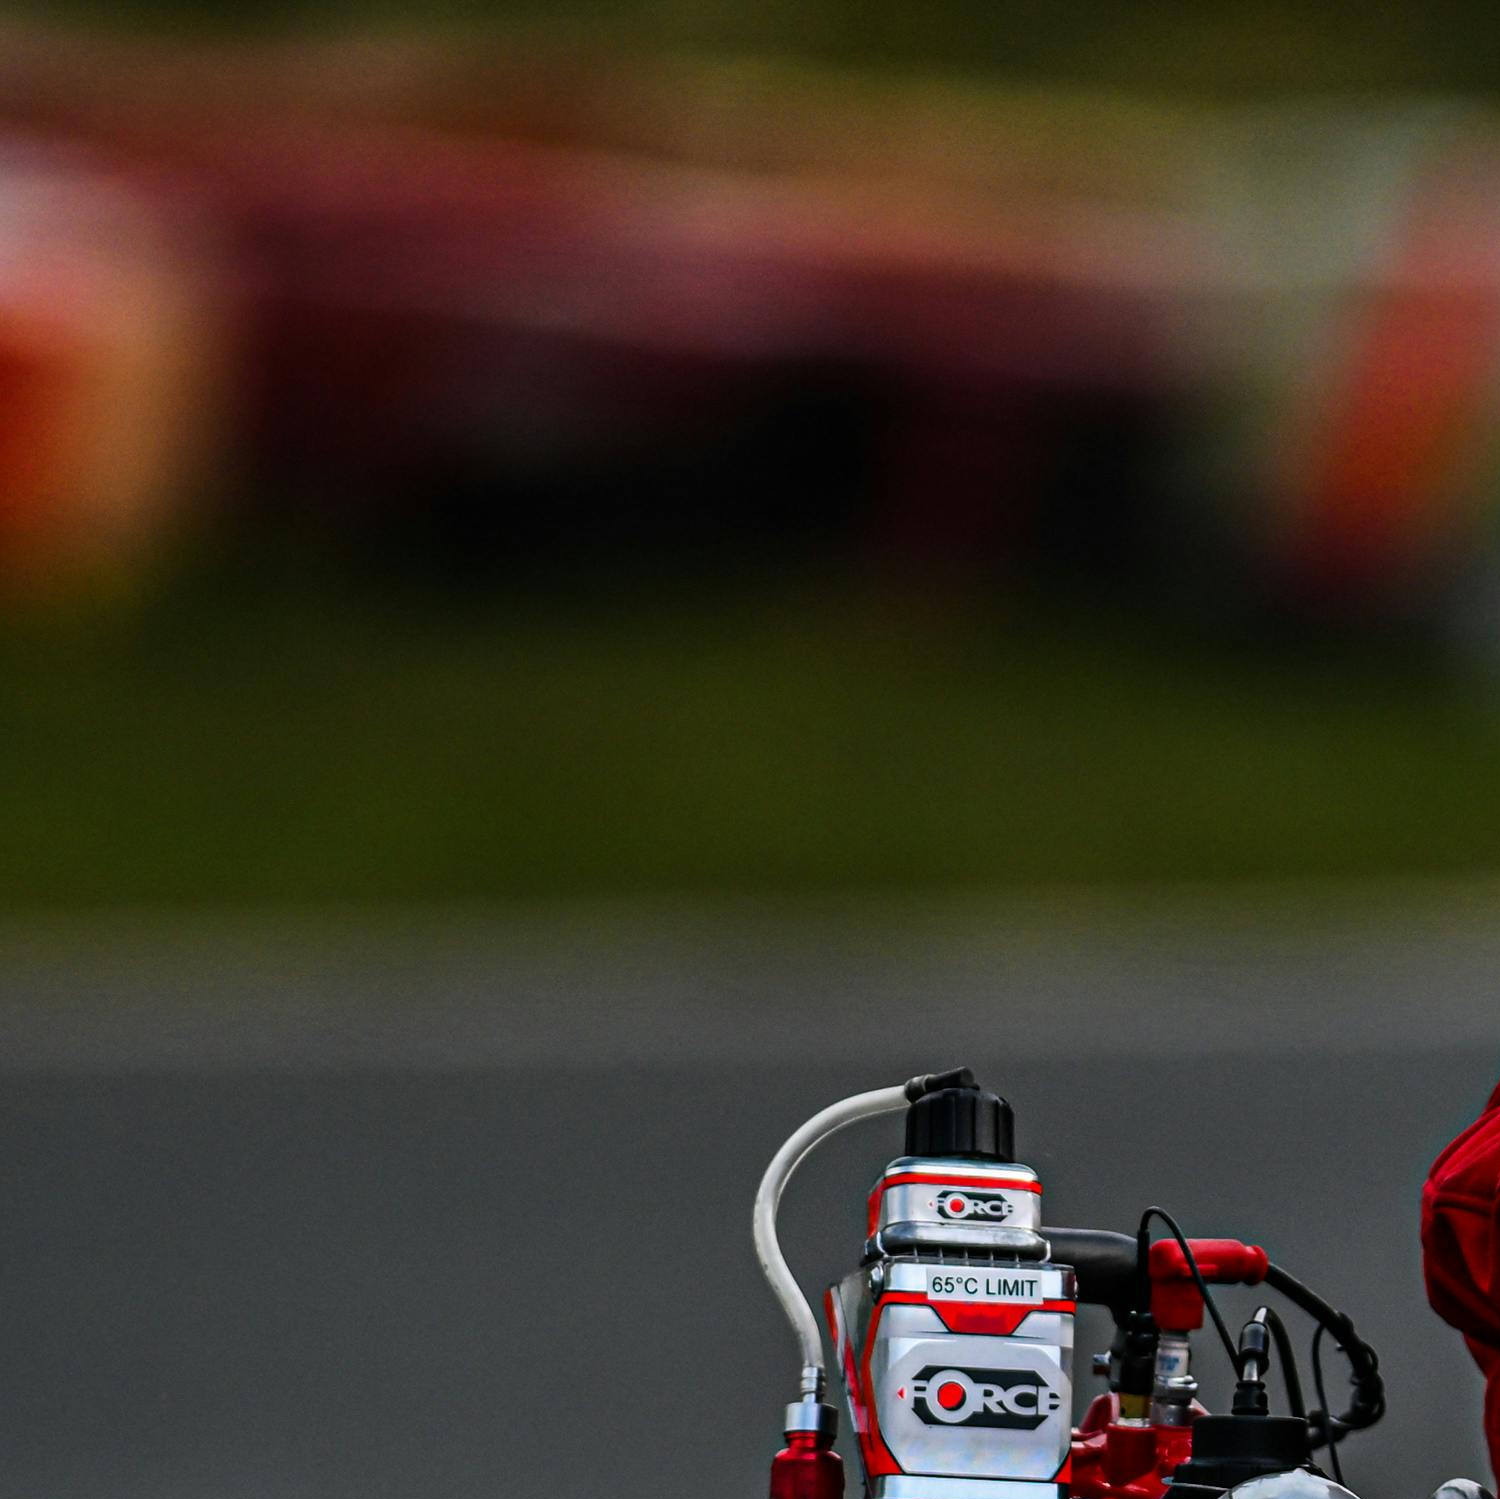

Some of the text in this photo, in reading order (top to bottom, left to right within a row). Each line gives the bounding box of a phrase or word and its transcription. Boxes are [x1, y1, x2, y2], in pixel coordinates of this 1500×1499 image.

[935, 1191, 1014, 1220] FORCE
[932, 1277, 1038, 1297] 65°C LIMIT
[908, 1368, 1061, 1424] FORCE
